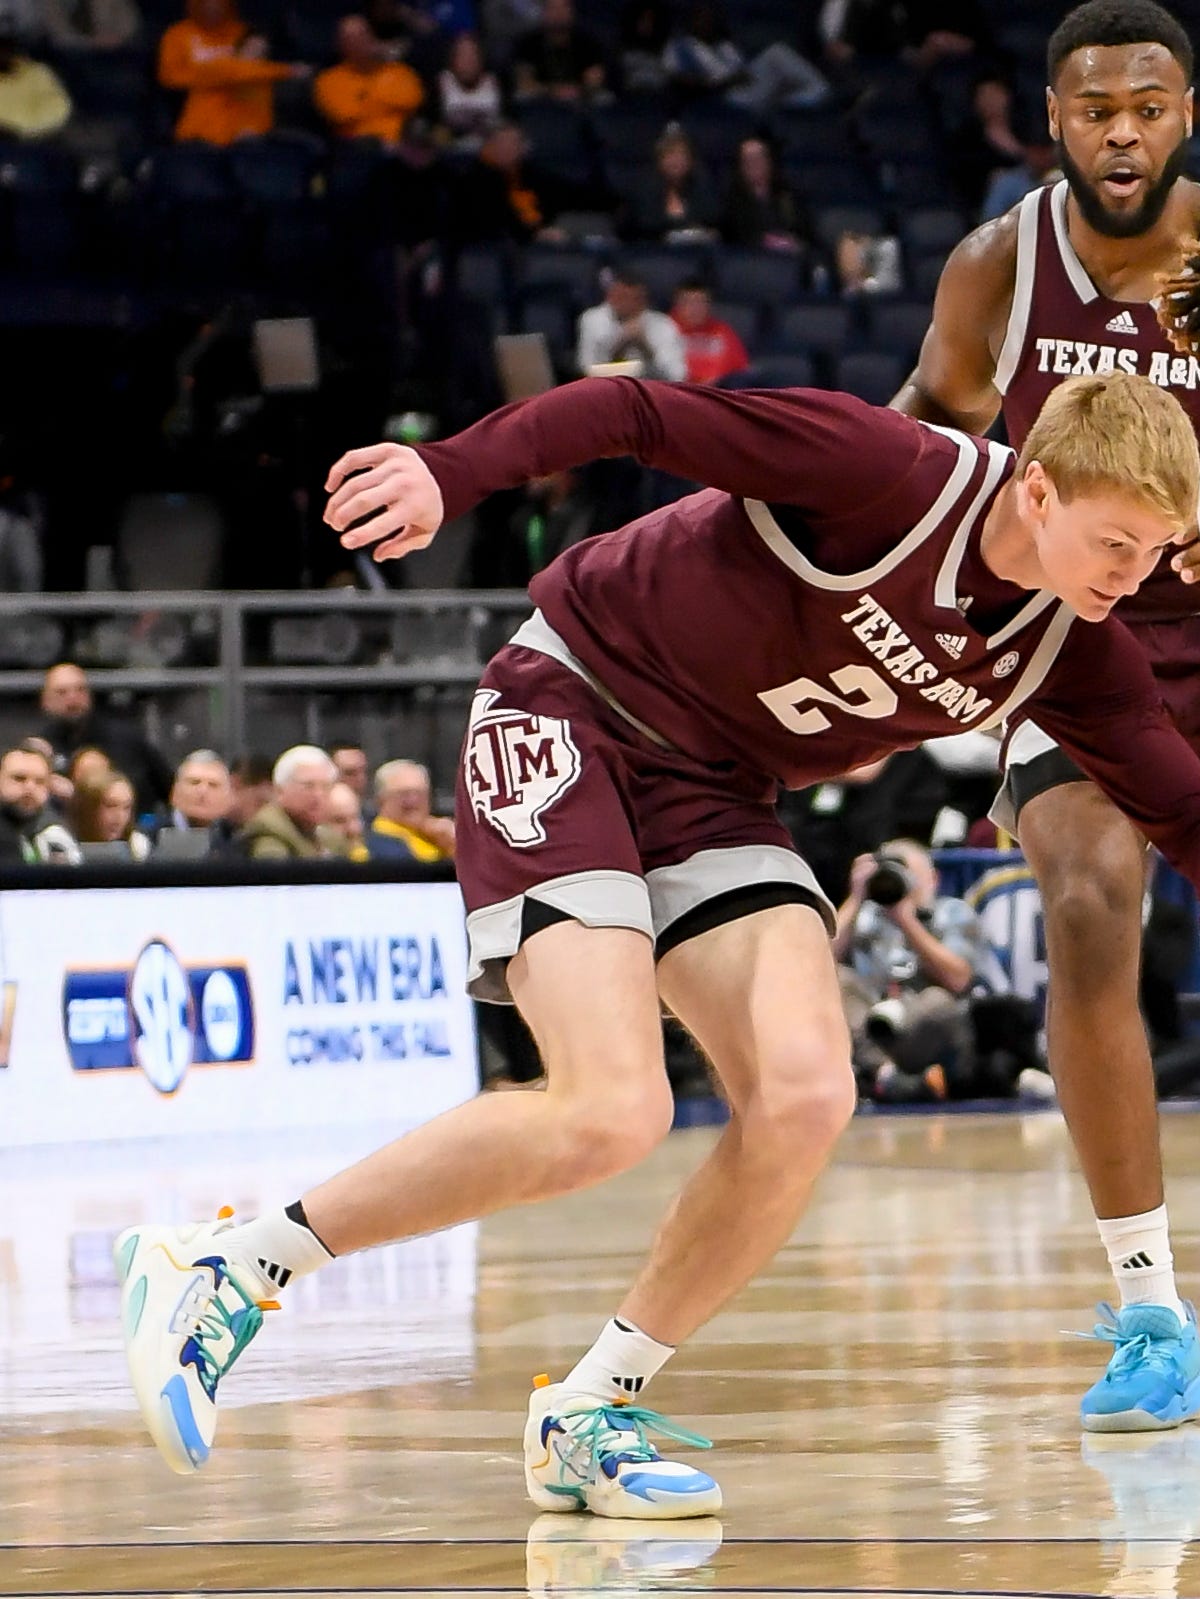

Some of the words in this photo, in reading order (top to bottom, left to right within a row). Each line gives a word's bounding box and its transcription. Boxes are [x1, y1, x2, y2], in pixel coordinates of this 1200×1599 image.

[1035, 338, 1138, 376] TEXAS
[840, 593, 939, 684] TEXAS
[919, 677, 993, 724] A&M
[757, 664, 898, 735] 2
[283, 940, 304, 1005] A
[309, 936, 376, 1003] NEW
[389, 935, 447, 1001] ERA
